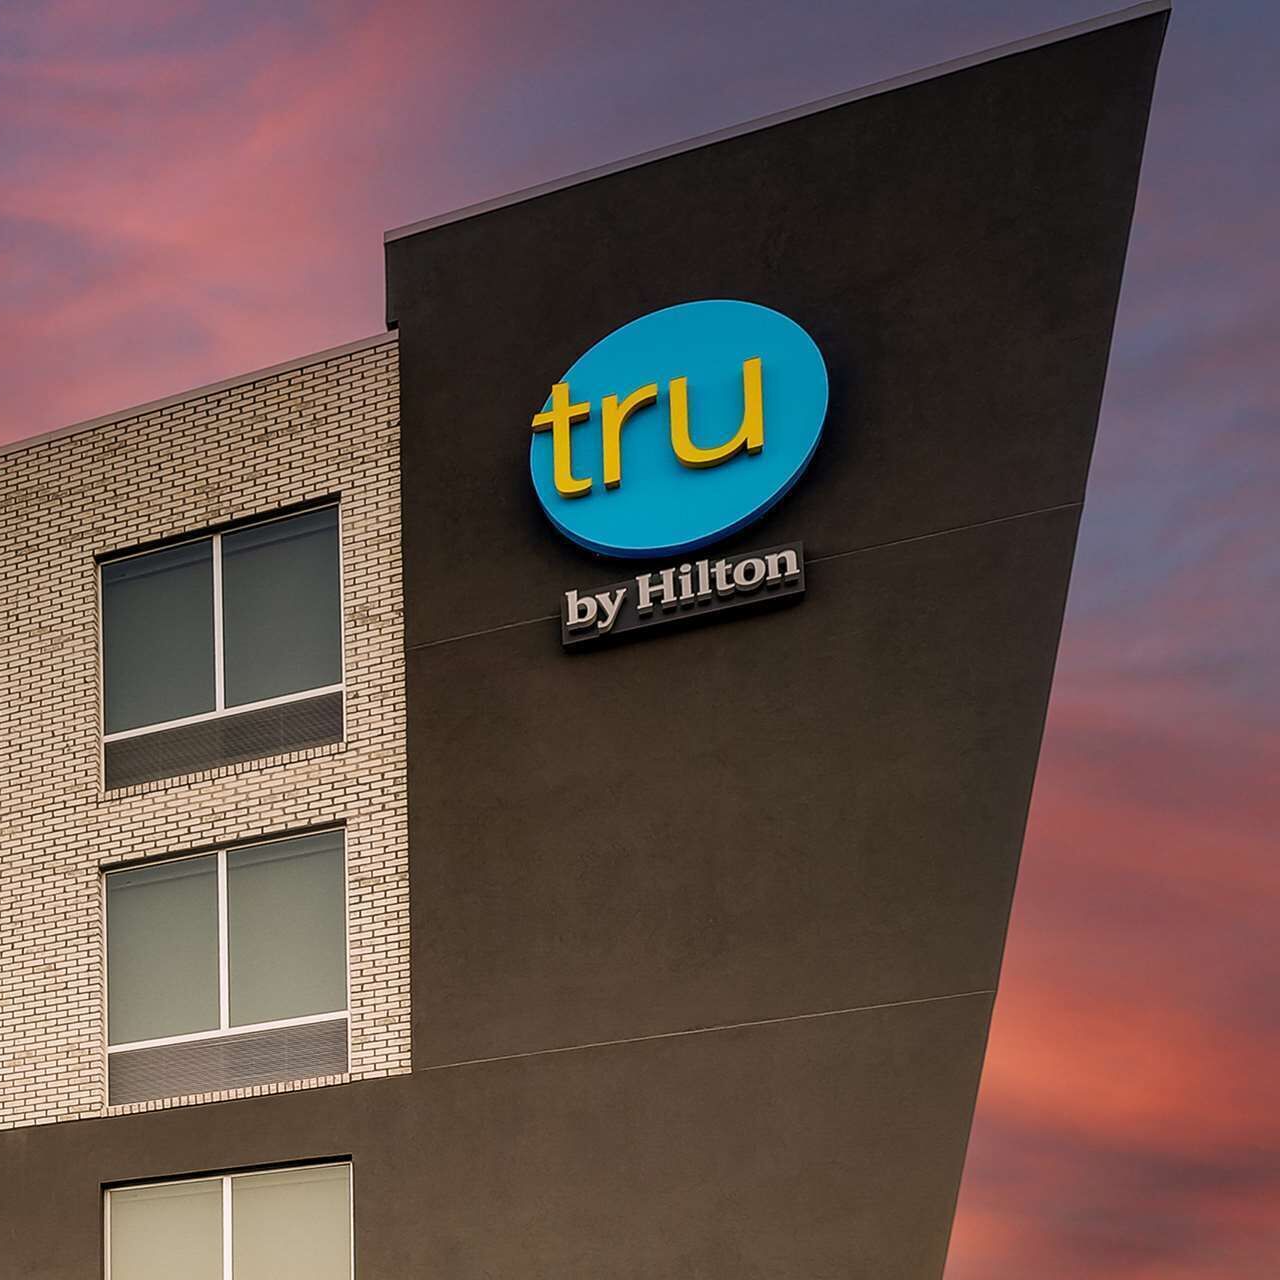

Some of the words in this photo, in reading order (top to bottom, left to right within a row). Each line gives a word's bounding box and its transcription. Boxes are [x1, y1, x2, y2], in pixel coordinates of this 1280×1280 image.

[532, 357, 763, 498] tru
[564, 588, 627, 632] by
[636, 547, 800, 614] Hilton
